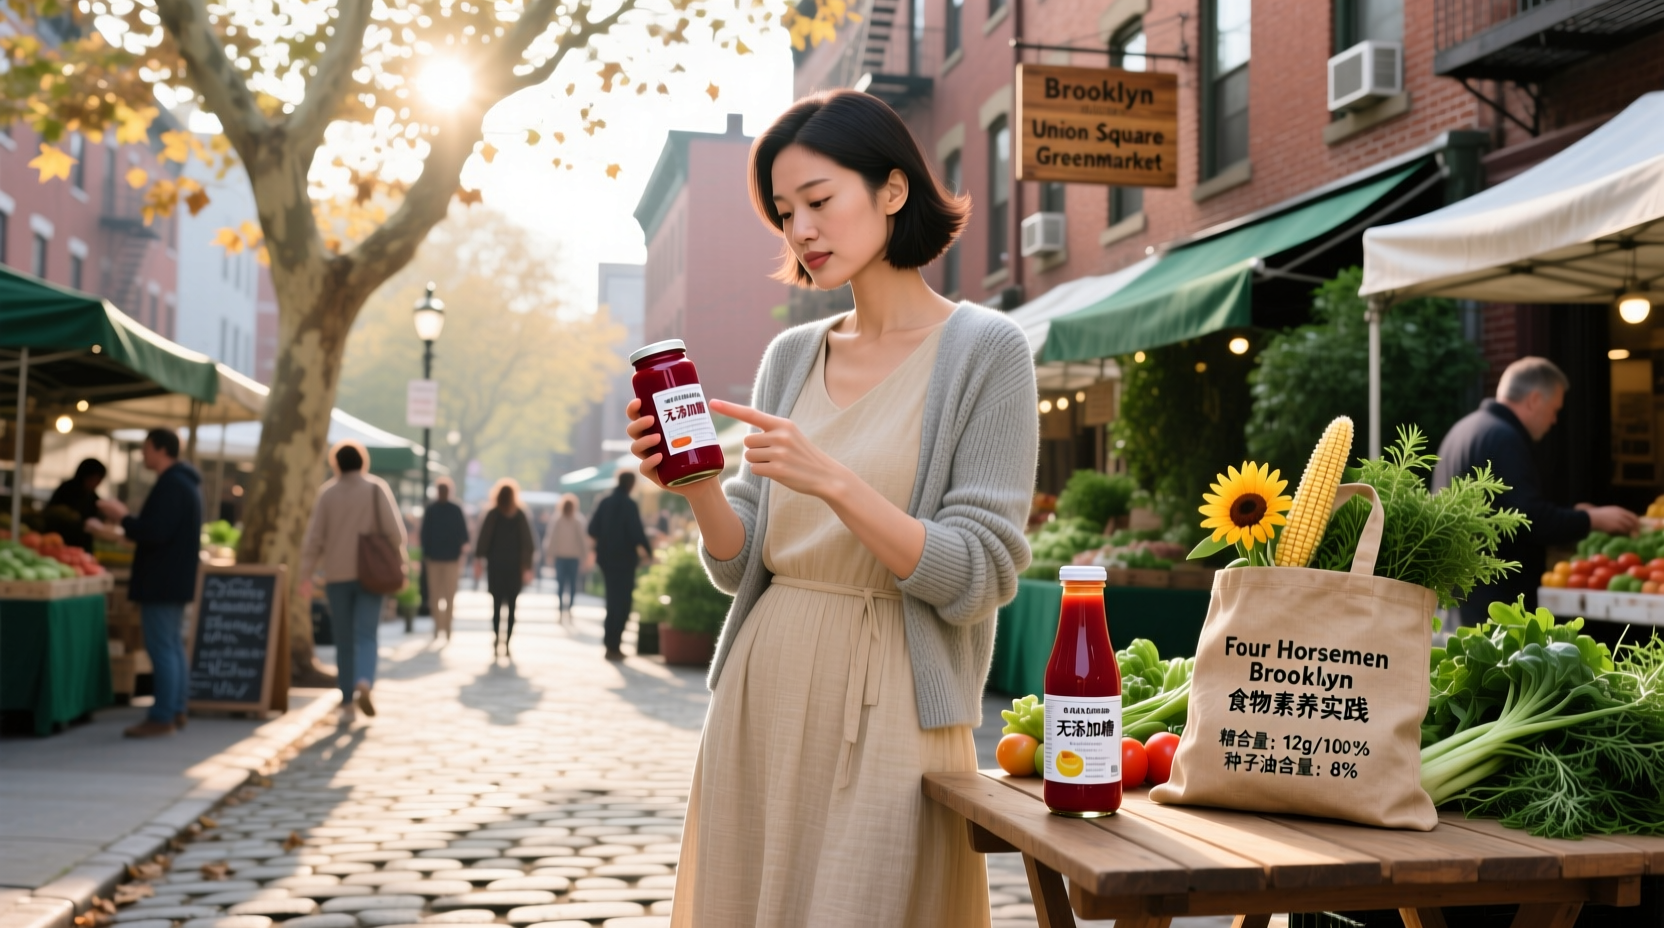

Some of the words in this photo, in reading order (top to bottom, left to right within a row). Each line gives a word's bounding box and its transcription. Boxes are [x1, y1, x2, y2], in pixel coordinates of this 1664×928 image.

[1045, 78, 1153, 110] Brooklyn
[1032, 119, 1089, 141] Union
[1096, 122, 1164, 147] Square
[1036, 147, 1162, 171] Greenmarket
[1225, 636, 1271, 658] Four
[1277, 639, 1389, 669] Horsemen
[1249, 662, 1353, 691] Brooklyn
[1228, 687, 1369, 723] 食物素养实践
[1330, 761, 1358, 779] 8%
